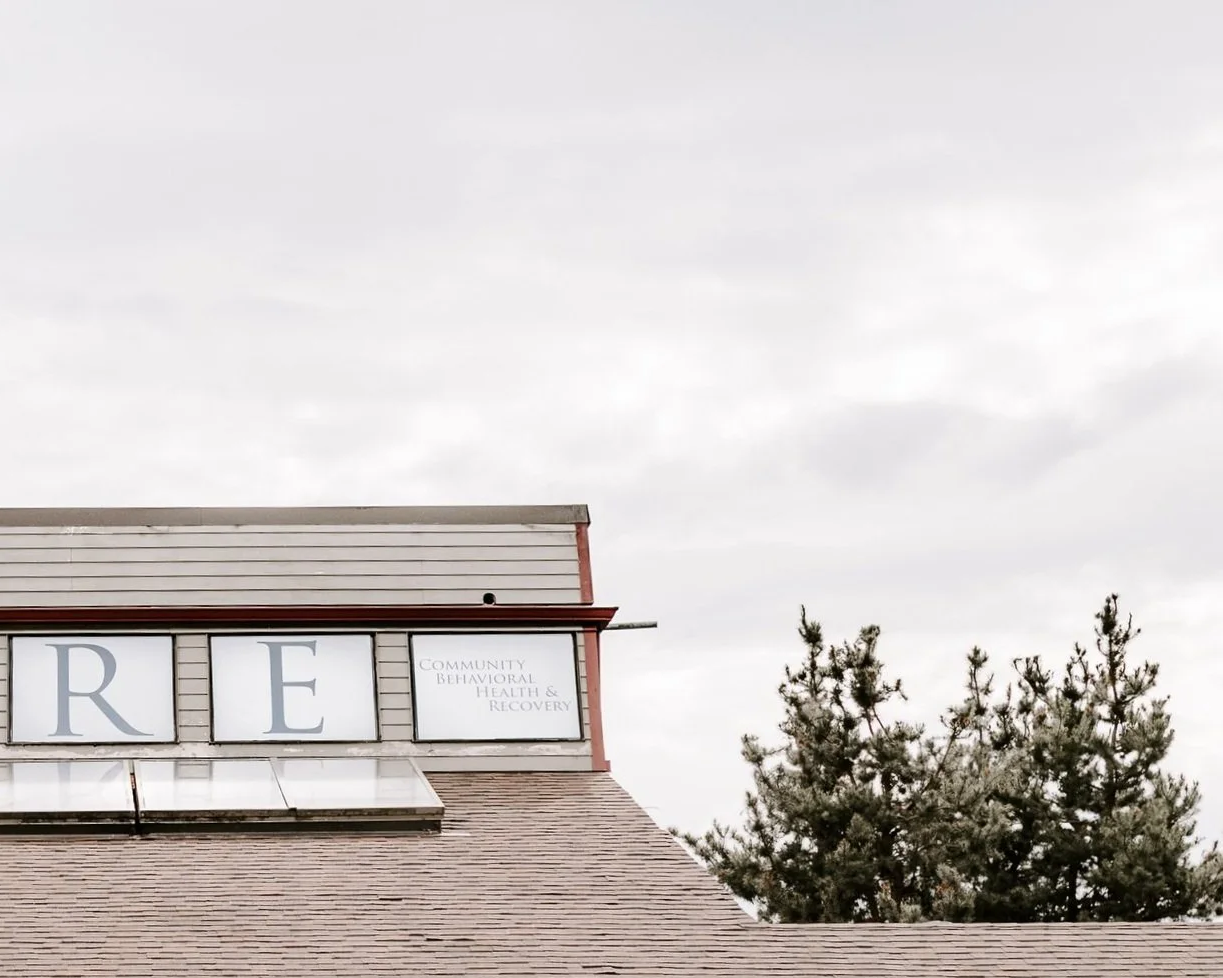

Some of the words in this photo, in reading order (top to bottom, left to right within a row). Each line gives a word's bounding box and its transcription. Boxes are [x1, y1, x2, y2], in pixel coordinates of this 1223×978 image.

[419, 658, 526, 671] COMMUNITY
[436, 673, 537, 685] BEHAVIORAL
[476, 686, 540, 698] HEALTH
[545, 686, 558, 698] &
[489, 700, 572, 712] RECOVERY
